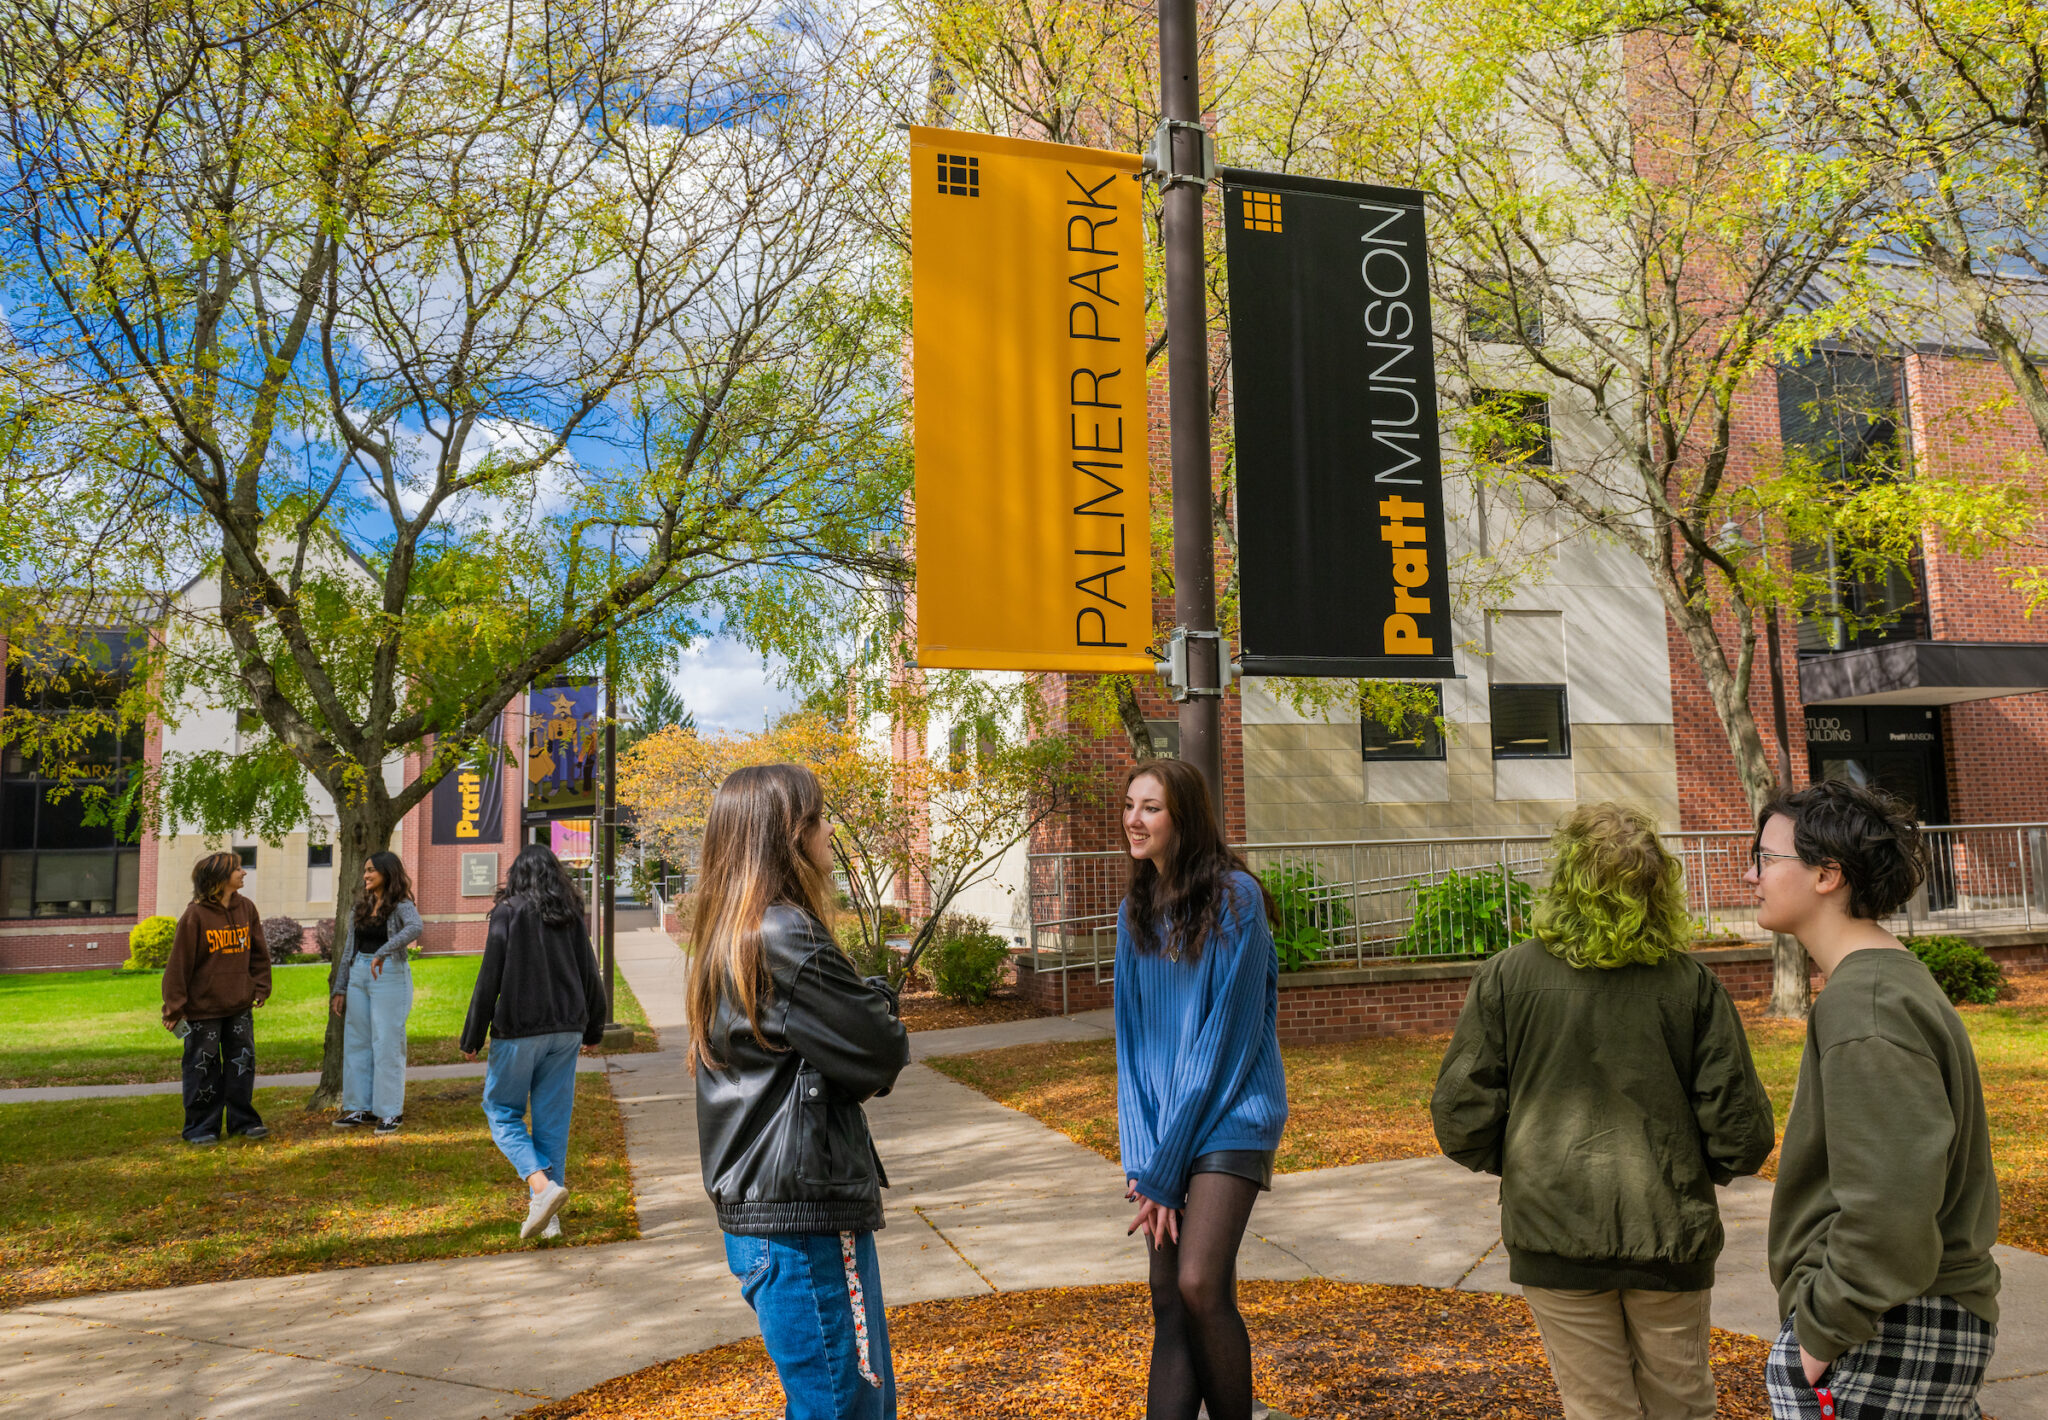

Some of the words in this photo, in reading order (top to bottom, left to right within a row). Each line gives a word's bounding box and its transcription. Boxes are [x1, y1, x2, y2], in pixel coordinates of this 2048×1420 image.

[1067, 169, 1120, 342] PARK
[1359, 203, 1424, 486] MUNSON
[1071, 367, 1127, 649] PALMER
[1379, 494, 1434, 655] Pratt
[455, 771, 480, 838] Pratt
